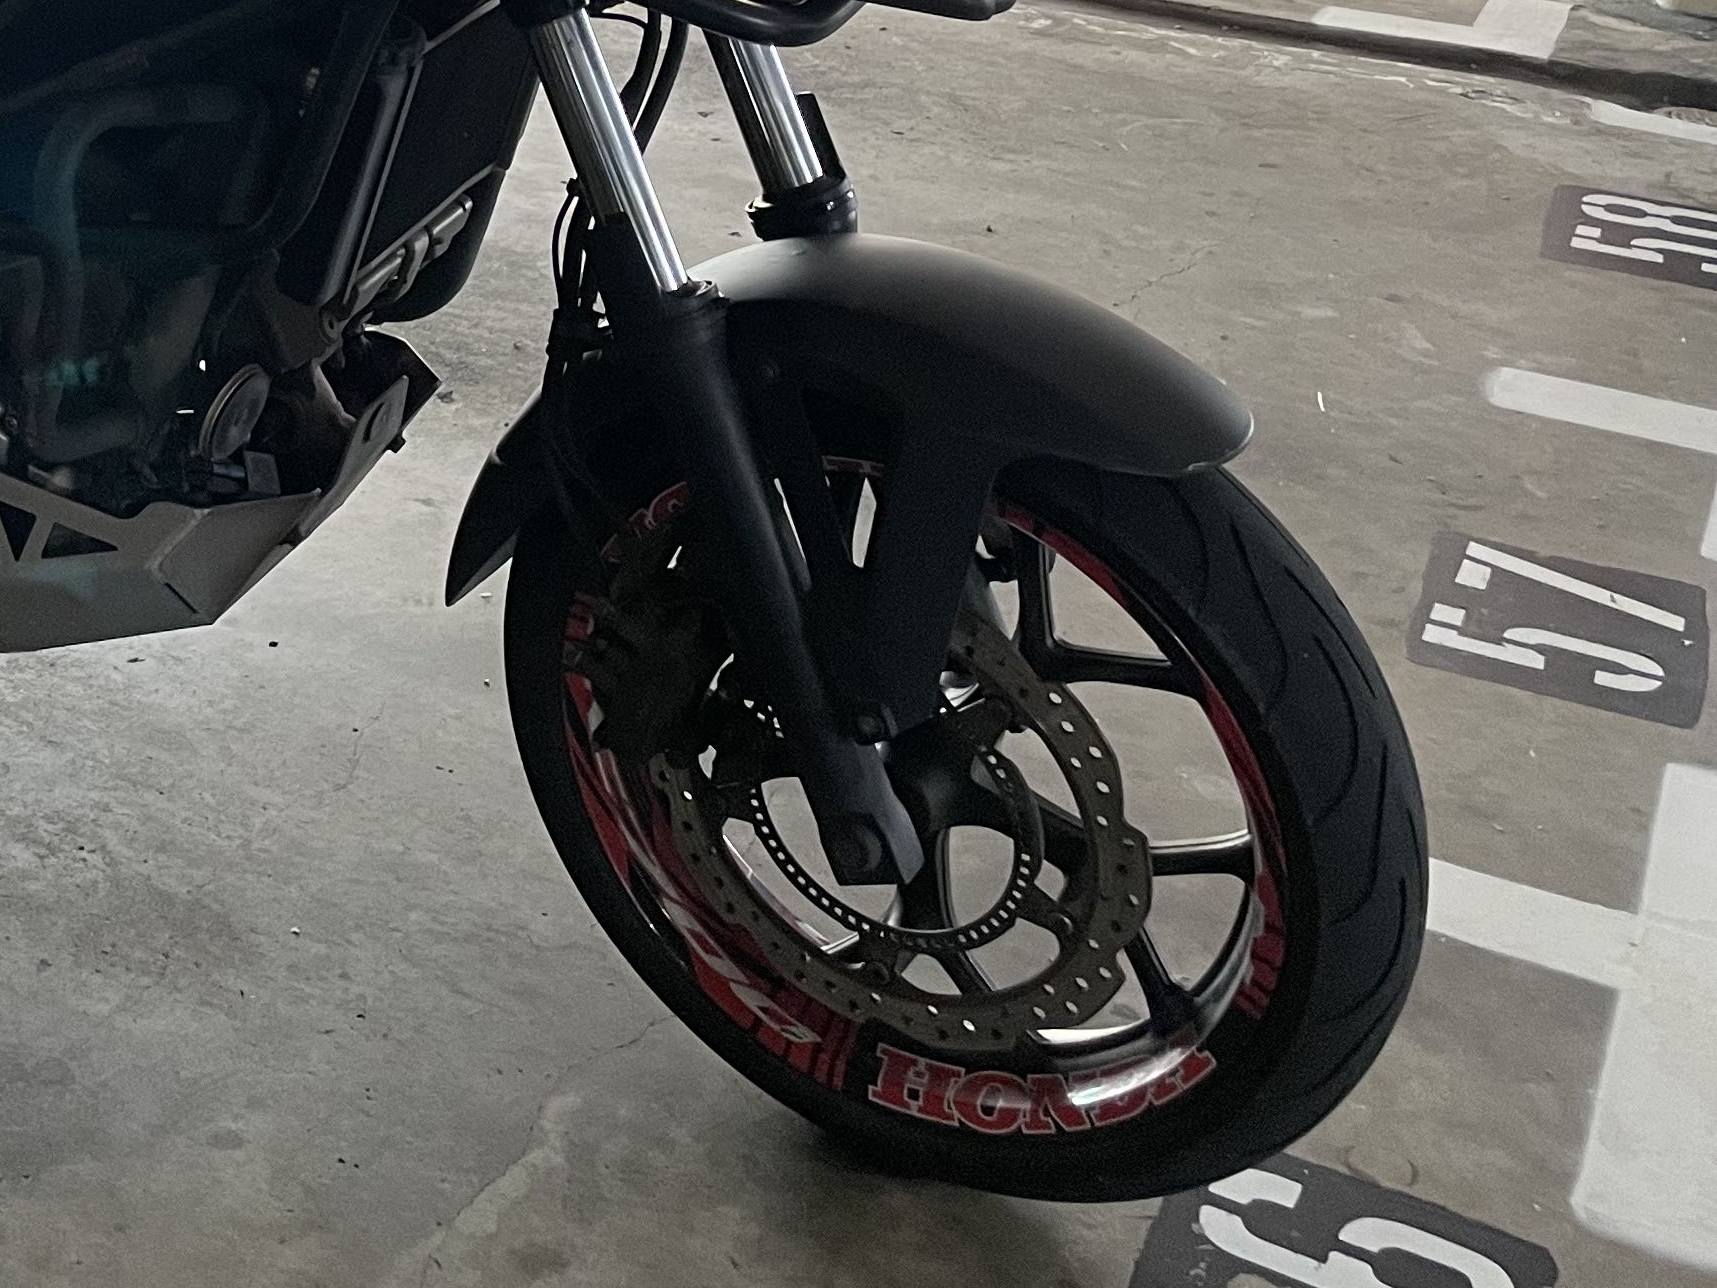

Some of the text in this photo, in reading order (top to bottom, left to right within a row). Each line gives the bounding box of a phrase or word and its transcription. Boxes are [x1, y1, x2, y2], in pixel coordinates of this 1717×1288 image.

[1421, 540, 1685, 693] 57
[868, 1032, 1218, 1135] HONDA
[1198, 1168, 1515, 1288] 6
